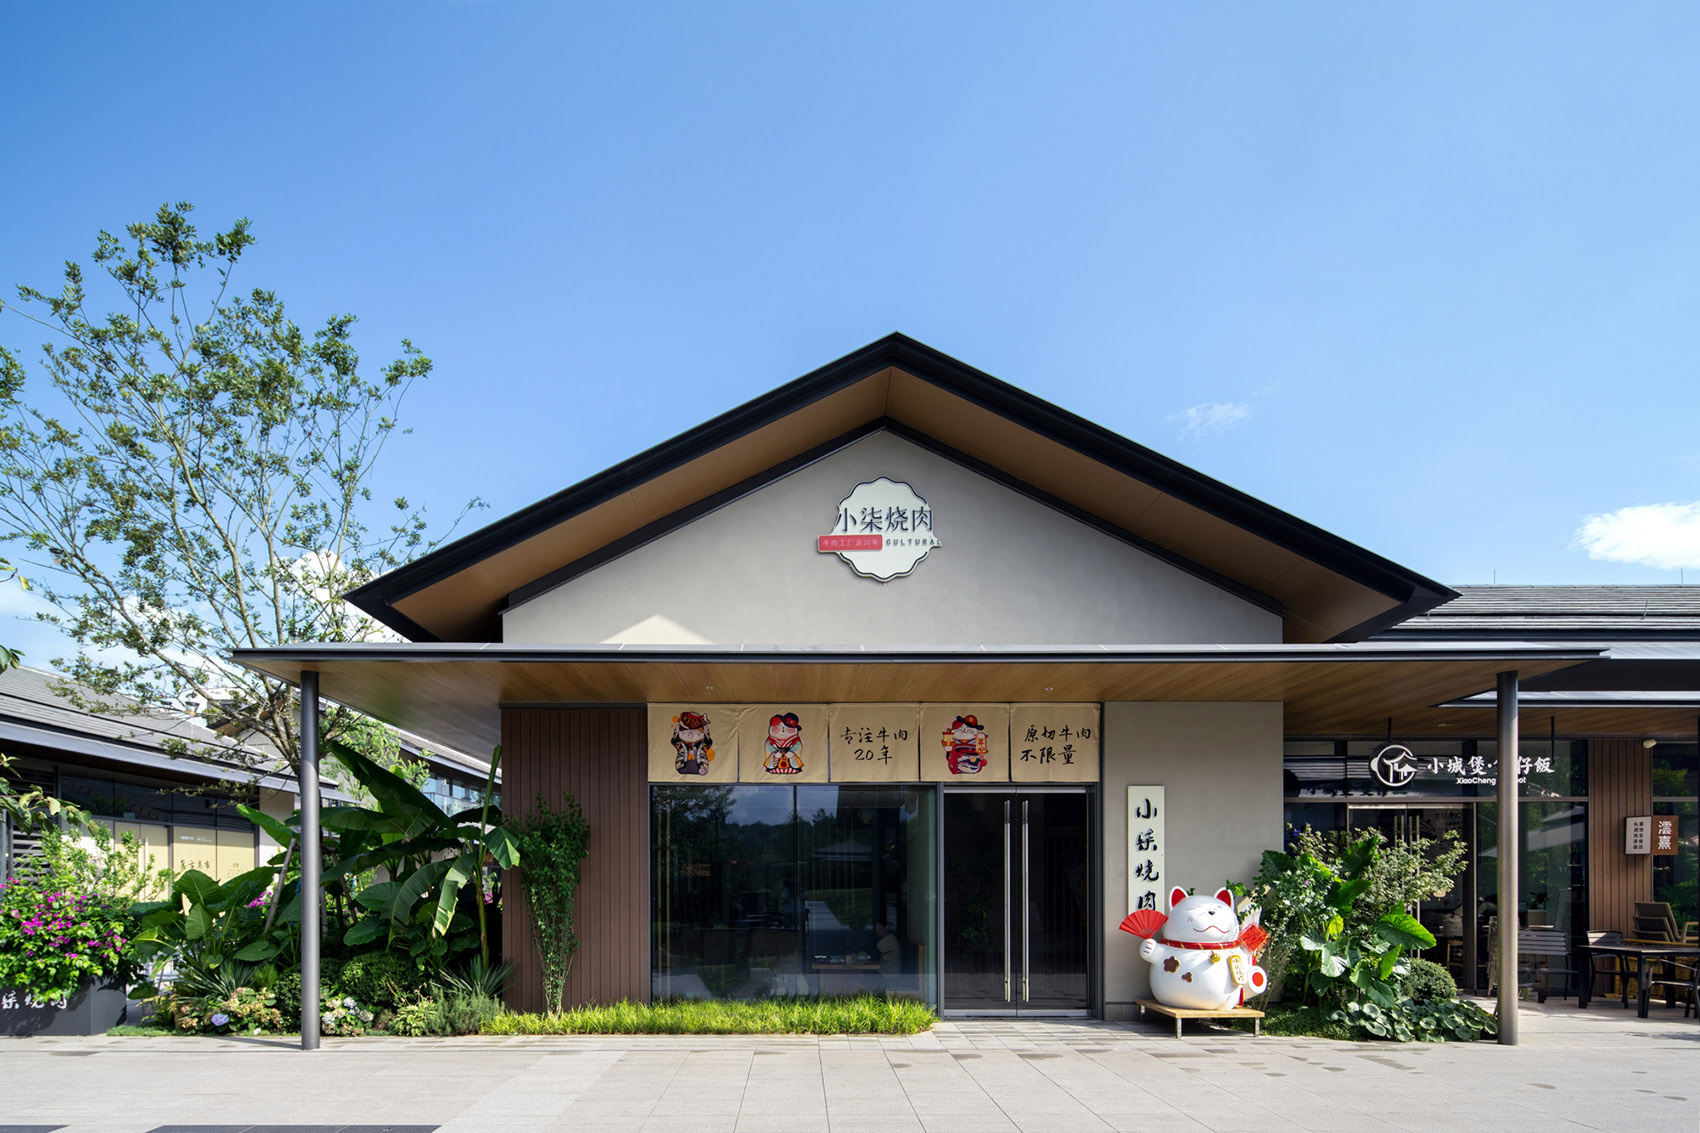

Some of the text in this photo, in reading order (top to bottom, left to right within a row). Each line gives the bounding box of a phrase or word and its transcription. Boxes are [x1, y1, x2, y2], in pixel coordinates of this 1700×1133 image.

[835, 506, 933, 532] 小柒烧肉
[886, 539, 942, 547] CULTURAL
[841, 726, 908, 744] 专注牛肉
[1024, 725, 1091, 742] 原切牛肉
[854, 745, 892, 765] 20年
[1020, 745, 1076, 765] 不限量
[1427, 756, 1555, 775] 小城煲·仔飯
